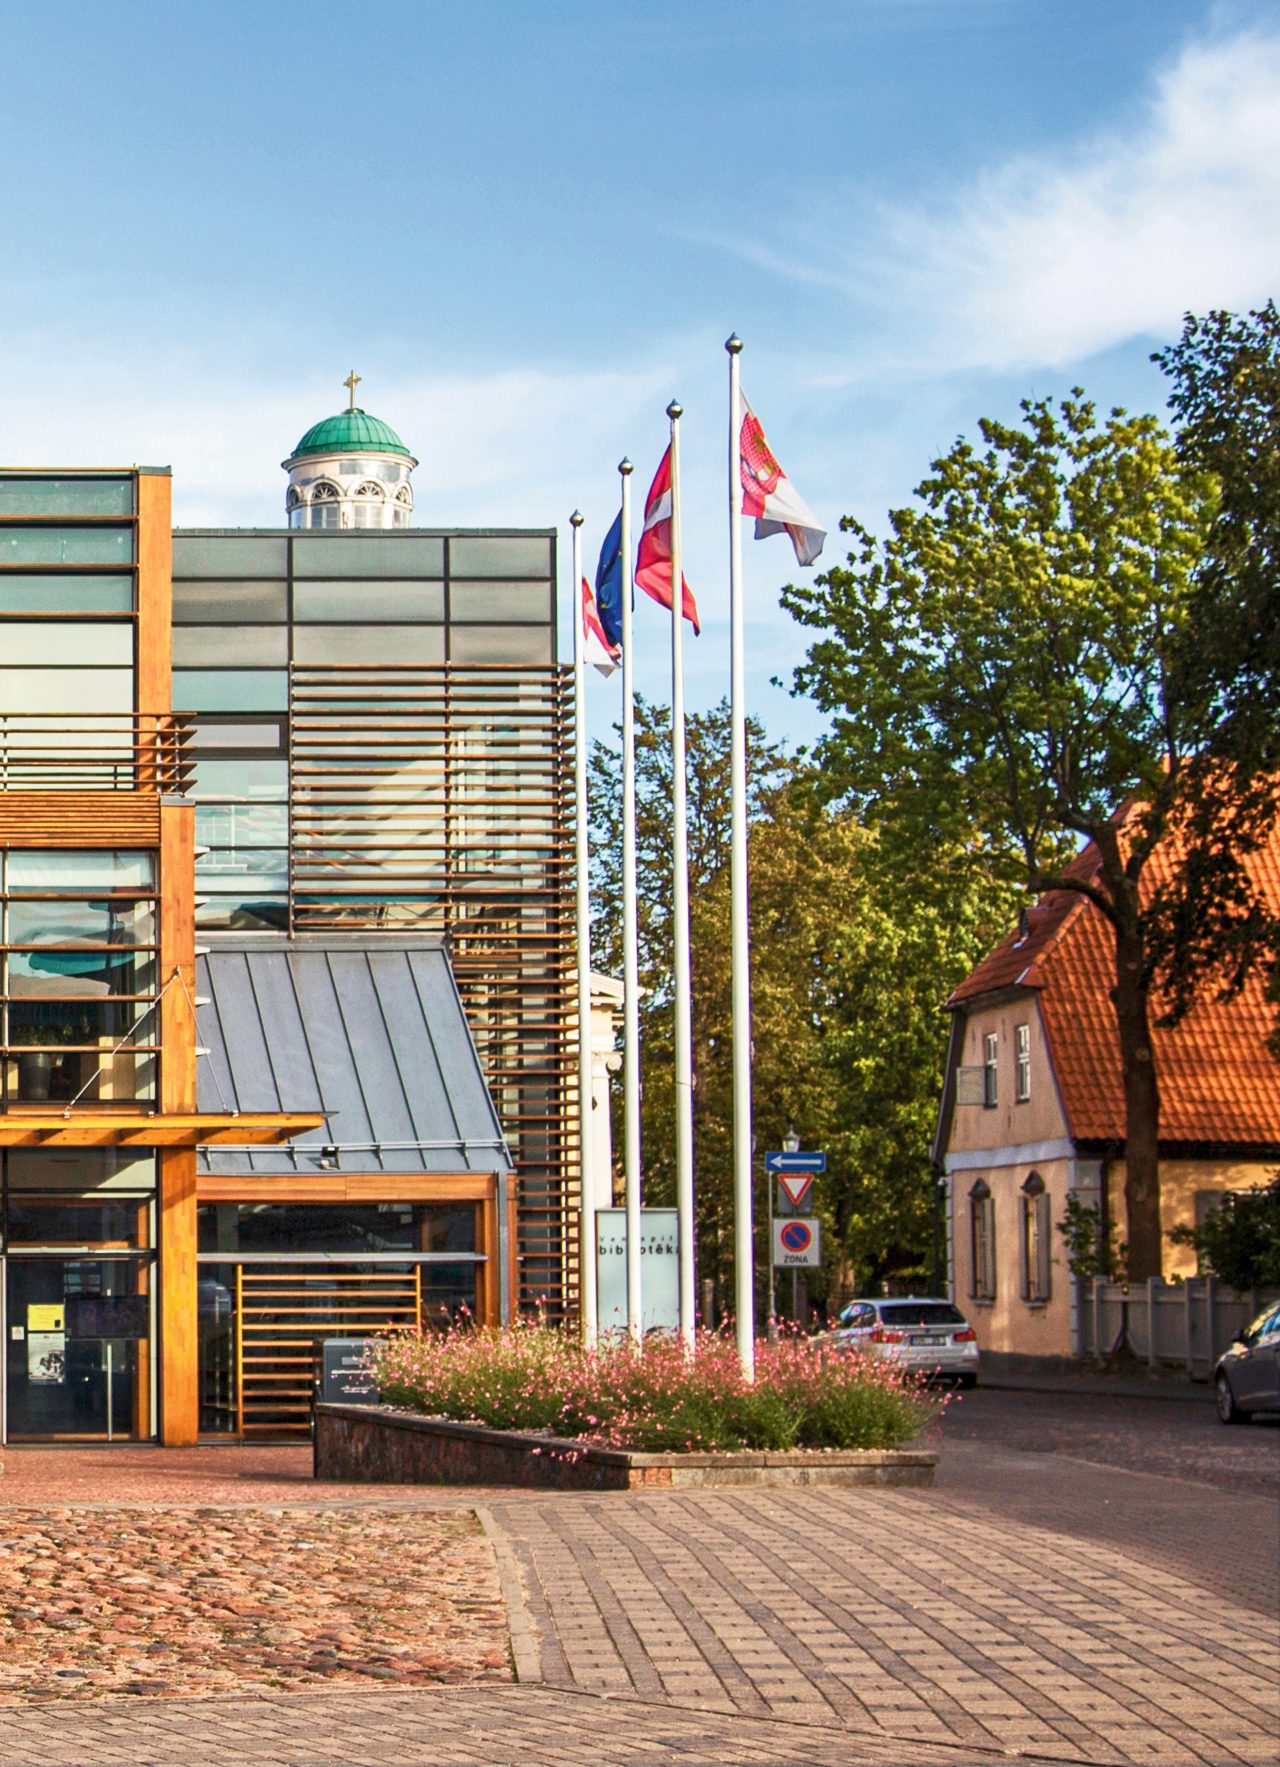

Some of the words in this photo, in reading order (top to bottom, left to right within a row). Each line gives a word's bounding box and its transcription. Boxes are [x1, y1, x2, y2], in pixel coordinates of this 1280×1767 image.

[600, 1235, 675, 1243] Venspil
[599, 1244, 679, 1255] bibotēk
[784, 1255, 808, 1263] ZONA
